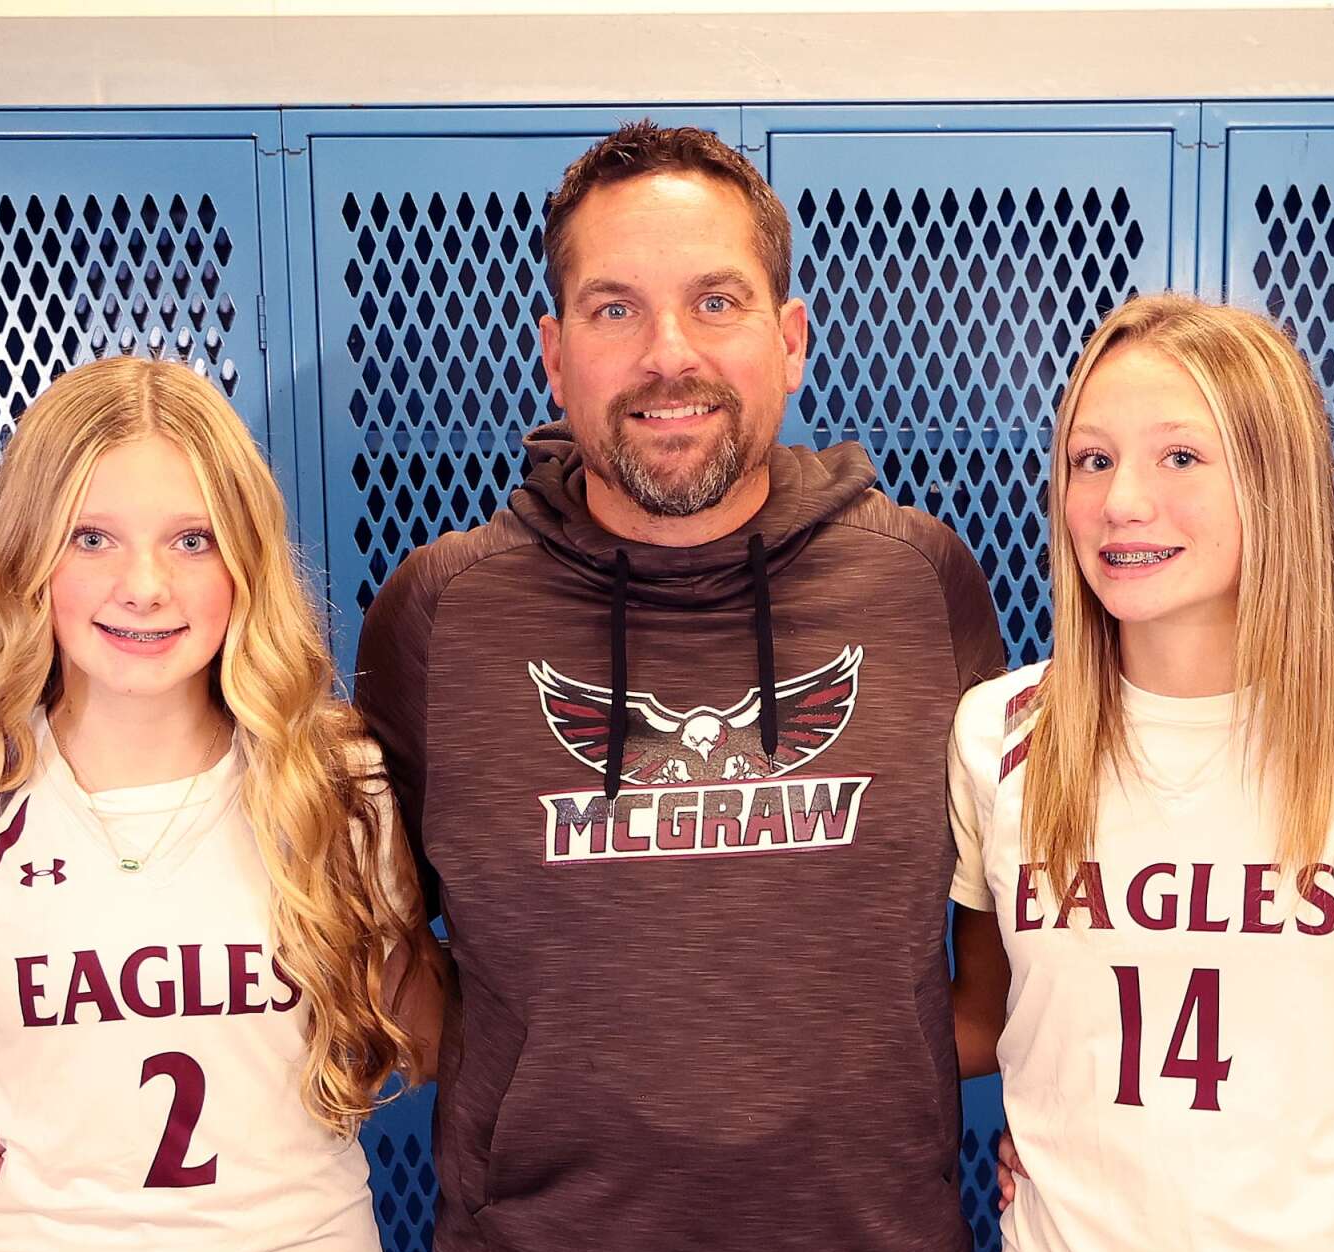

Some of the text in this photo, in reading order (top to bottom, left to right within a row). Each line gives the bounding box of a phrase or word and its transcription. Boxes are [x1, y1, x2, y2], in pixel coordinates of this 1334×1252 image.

[549, 782, 863, 856] MCGRAW
[14, 943, 303, 1028] EAGLES
[1110, 965, 1234, 1112] 14
[139, 1051, 218, 1188] 2
